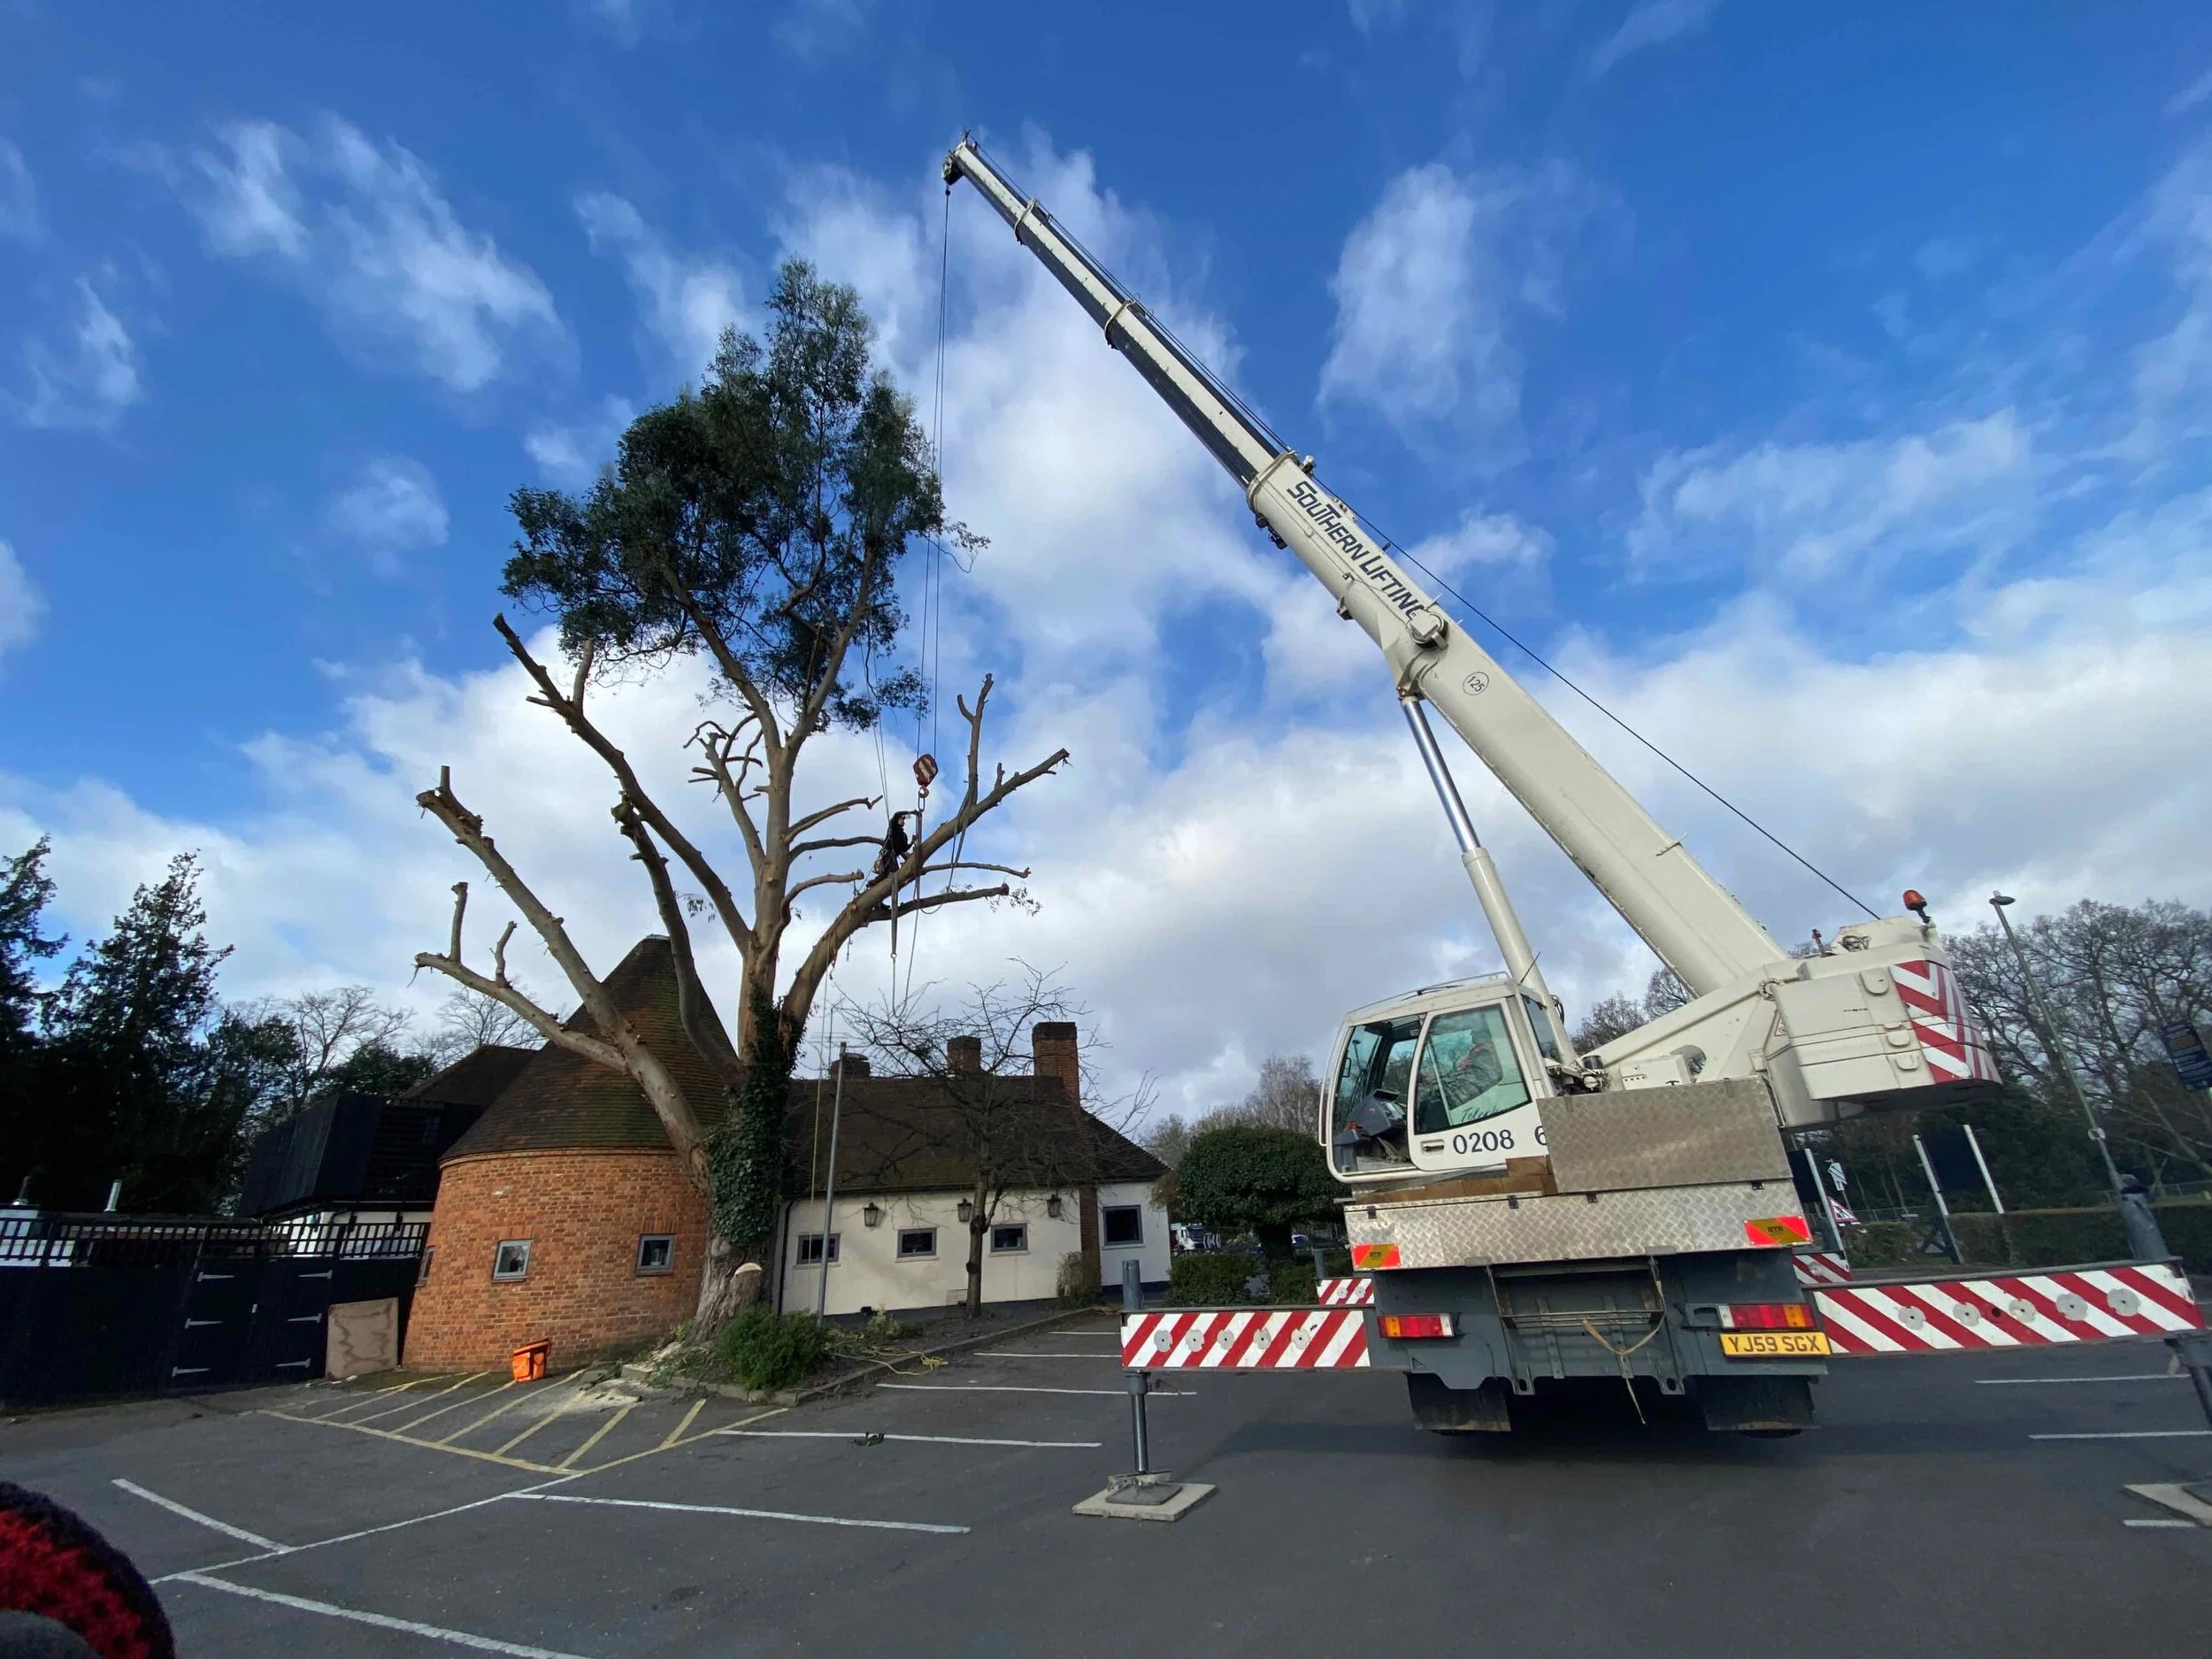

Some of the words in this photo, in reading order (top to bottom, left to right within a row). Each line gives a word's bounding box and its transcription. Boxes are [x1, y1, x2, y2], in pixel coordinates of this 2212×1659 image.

[1286, 480, 1370, 561] SOUTHERN
[1467, 676, 1485, 692] 125
[1452, 1129, 1515, 1155] 0208
[1728, 1336, 1778, 1352] YJ59
[1782, 1334, 1821, 1352] SGX
